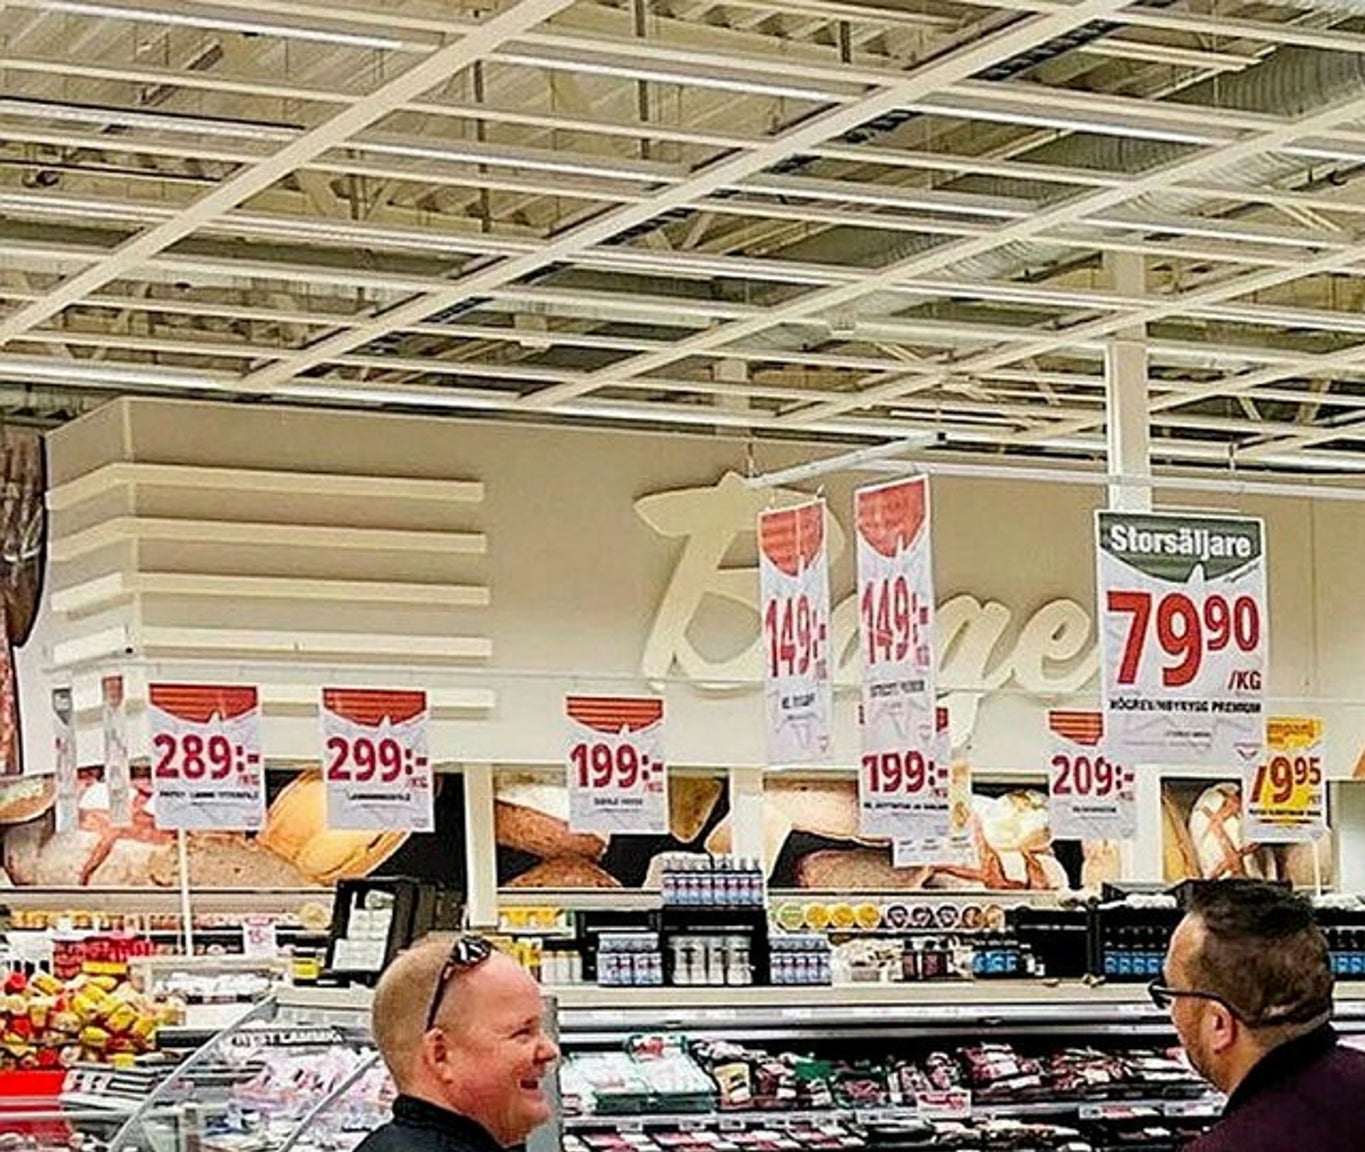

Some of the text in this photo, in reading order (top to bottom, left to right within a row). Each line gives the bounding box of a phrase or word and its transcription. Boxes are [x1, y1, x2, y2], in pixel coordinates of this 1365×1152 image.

[1110, 524, 1251, 557] Storsäljare
[1228, 671, 1262, 691] /KG
[153, 734, 260, 780] 289:-
[326, 736, 428, 781] 299:-
[570, 743, 664, 788] 199:-
[1051, 755, 1135, 796] 209:-
